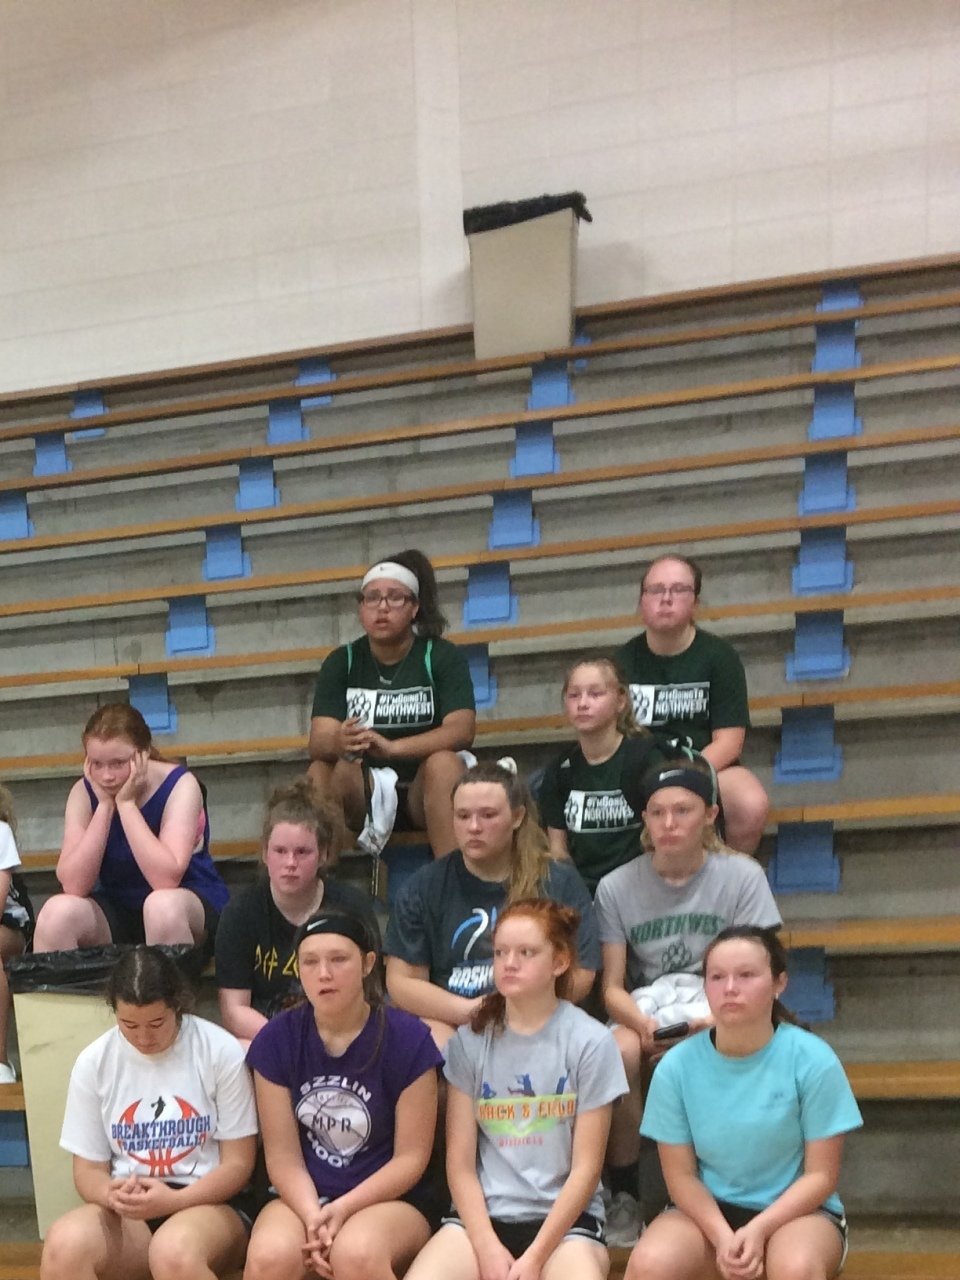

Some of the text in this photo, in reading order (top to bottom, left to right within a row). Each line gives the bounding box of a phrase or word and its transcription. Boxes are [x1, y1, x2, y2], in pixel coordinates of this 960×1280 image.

[376, 702, 432, 717] NORTHWEST
[654, 699, 707, 716] NOTHWEST
[584, 804, 634, 822] NORTHWES
[111, 1115, 211, 1140] BREAKTHROUGH
[123, 1134, 201, 1152] BASKETBALL
